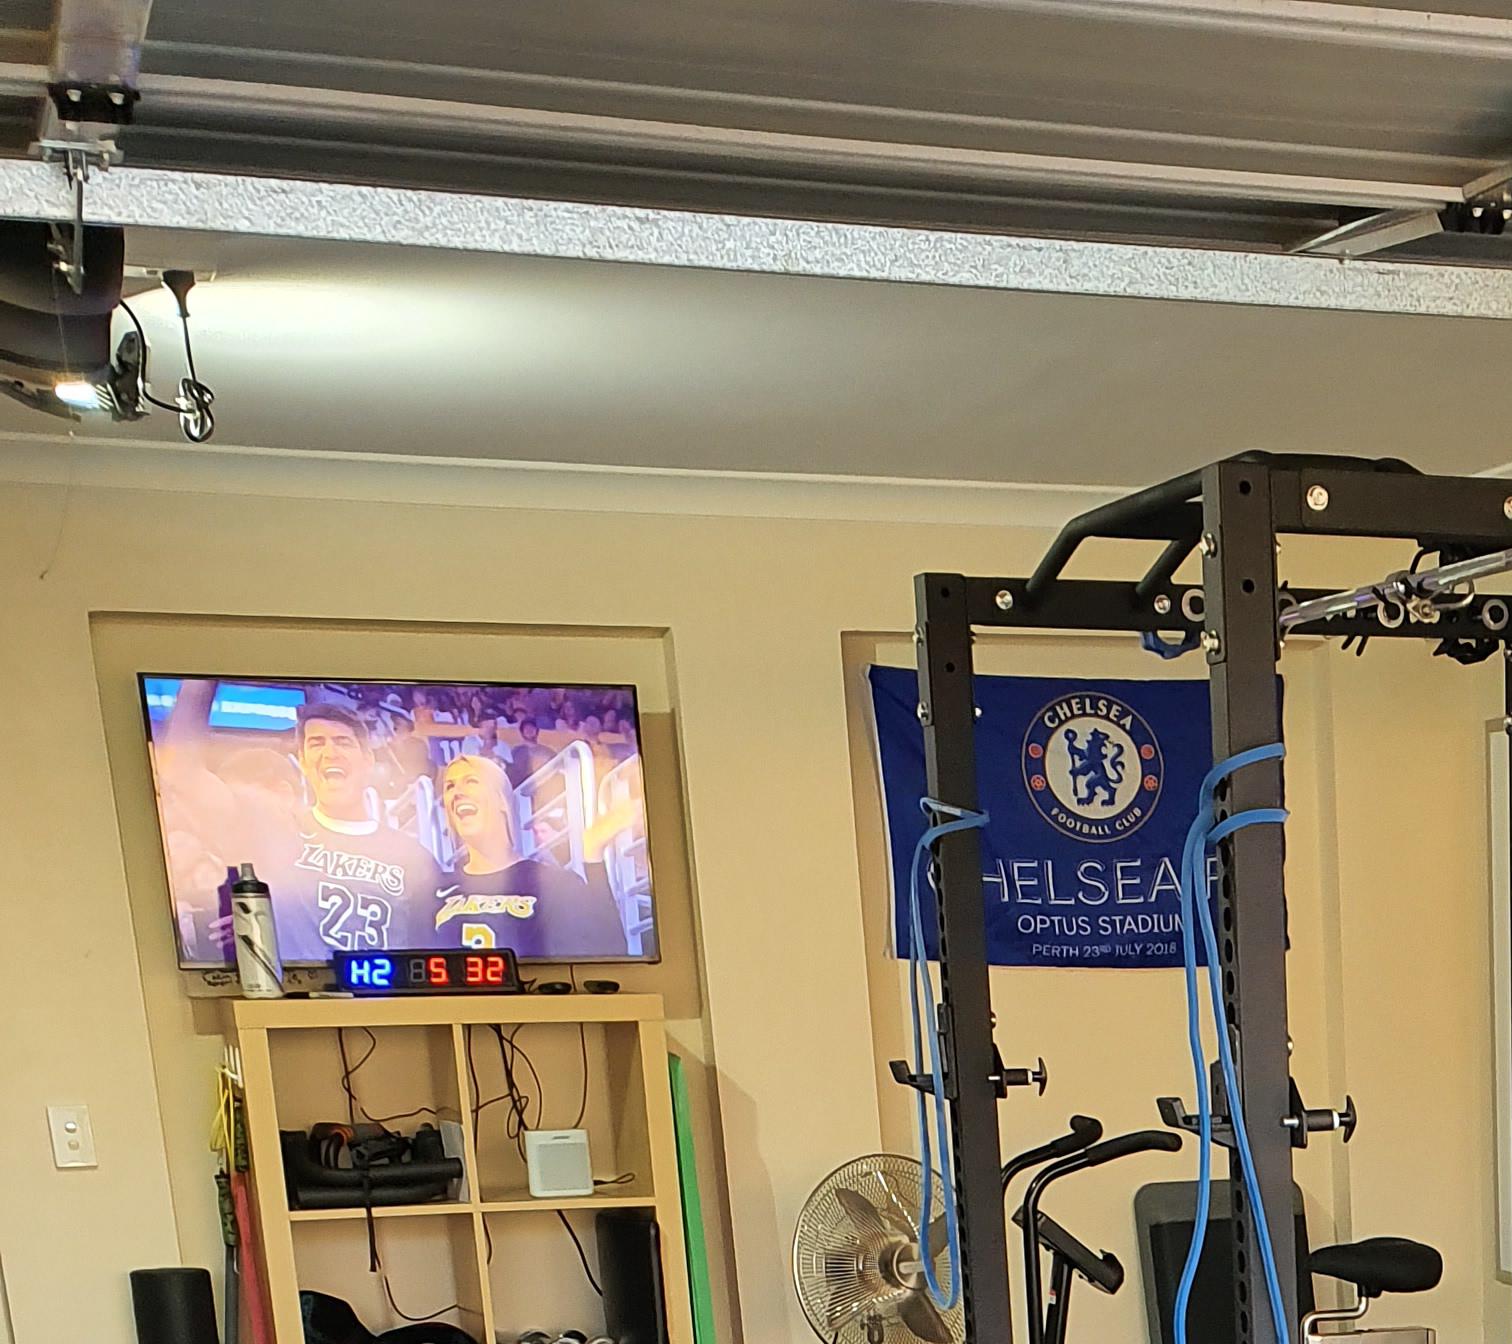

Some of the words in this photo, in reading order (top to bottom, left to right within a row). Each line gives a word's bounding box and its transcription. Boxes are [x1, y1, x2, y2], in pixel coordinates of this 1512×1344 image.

[1043, 697, 1134, 731] CHELSEA
[1050, 807, 1112, 836] FOOTBALL
[1115, 807, 1142, 830] CLUB
[294, 843, 405, 896] LAKERS
[319, 881, 391, 951] 23
[435, 895, 538, 930] LAKERS
[1018, 914, 1091, 936] OPTUS
[1032, 943, 1080, 958] PERTH
[1114, 942, 1143, 958] JULY
[1146, 941, 1177, 957] 2018
[466, 957, 504, 983] 32
